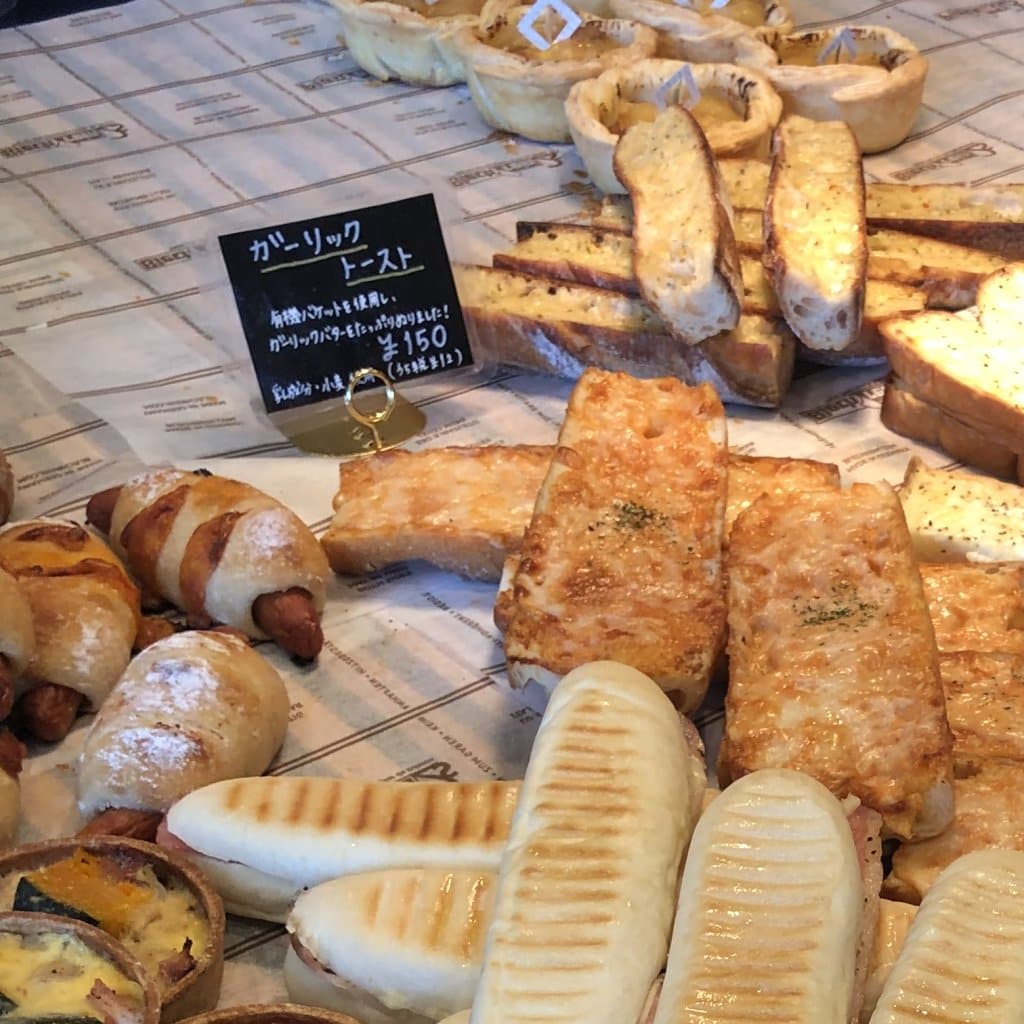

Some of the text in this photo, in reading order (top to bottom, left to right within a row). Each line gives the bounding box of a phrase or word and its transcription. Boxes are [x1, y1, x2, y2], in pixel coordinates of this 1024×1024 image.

[250, 220, 361, 262] ガーリック
[341, 246, 413, 280] トースト
[377, 325, 449, 362] ¥150
